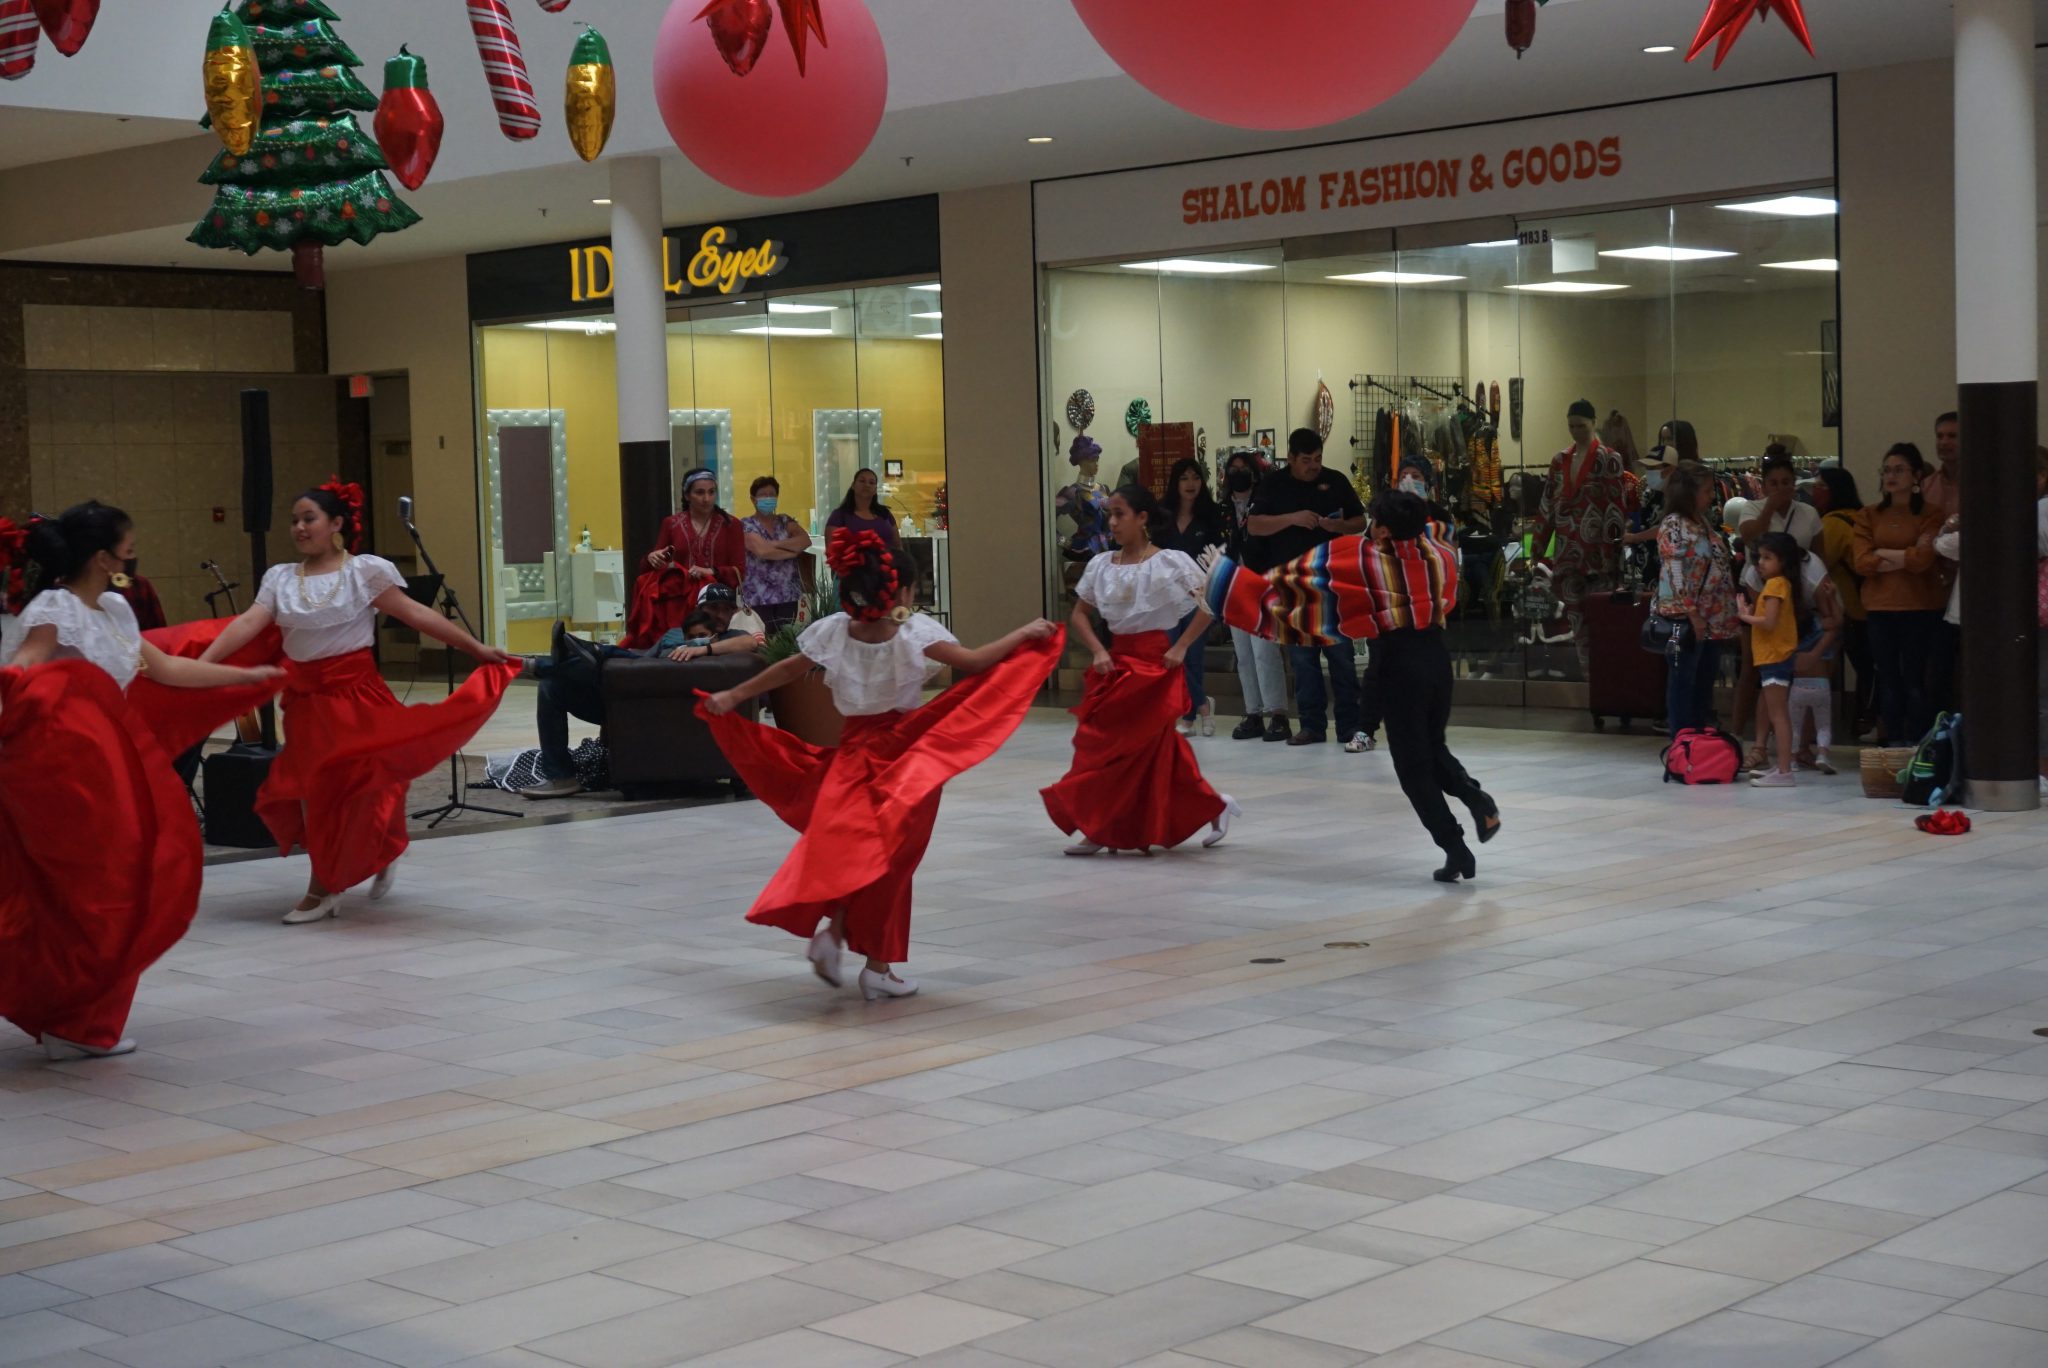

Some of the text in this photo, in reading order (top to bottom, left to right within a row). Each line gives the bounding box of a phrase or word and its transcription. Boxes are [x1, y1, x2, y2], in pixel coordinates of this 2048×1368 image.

[1182, 136, 1623, 225] SHALOM FASHION & GOODS
[687, 226, 777, 294] Eyes
